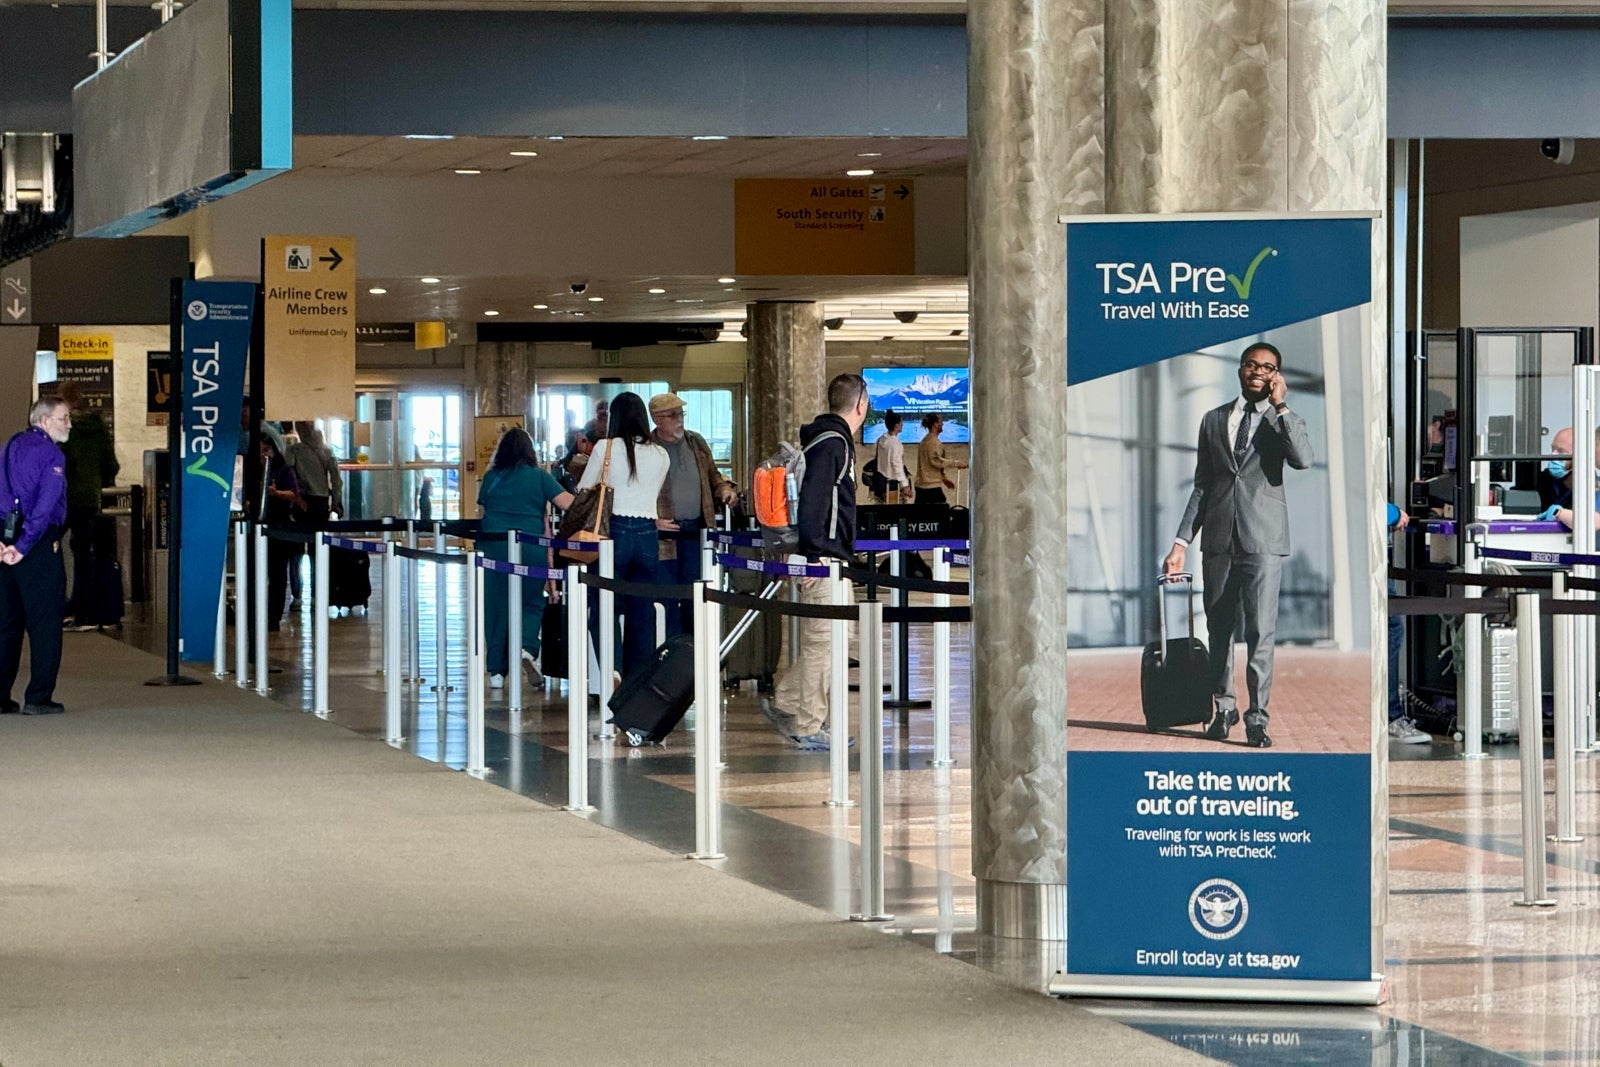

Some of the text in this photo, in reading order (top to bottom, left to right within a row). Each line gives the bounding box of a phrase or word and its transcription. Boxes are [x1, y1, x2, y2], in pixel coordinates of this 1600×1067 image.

[810, 186, 864, 198] All Gates
[776, 208, 864, 222] South Security
[828, 222, 864, 230] Screening
[1096, 262, 1162, 294] TSA
[268, 287, 348, 300] Airline Crew
[286, 303, 348, 316] Members
[1100, 301, 1250, 320] Travel With Ease
[289, 328, 348, 338] Uniformed Only
[62, 338, 109, 349] Check-in
[604, 352, 620, 364] EXIT
[192, 341, 220, 398] TSA
[919, 522, 939, 532] EXIT
[1144, 770, 1291, 792] Take the work
[1136, 795, 1299, 820] out of traveling.
[1125, 828, 1311, 843] Traveling for work is less work
[1159, 844, 1186, 857] with
[1189, 845, 1213, 857] TSA
[1136, 950, 1300, 970] Enroll today at tsa.gov
